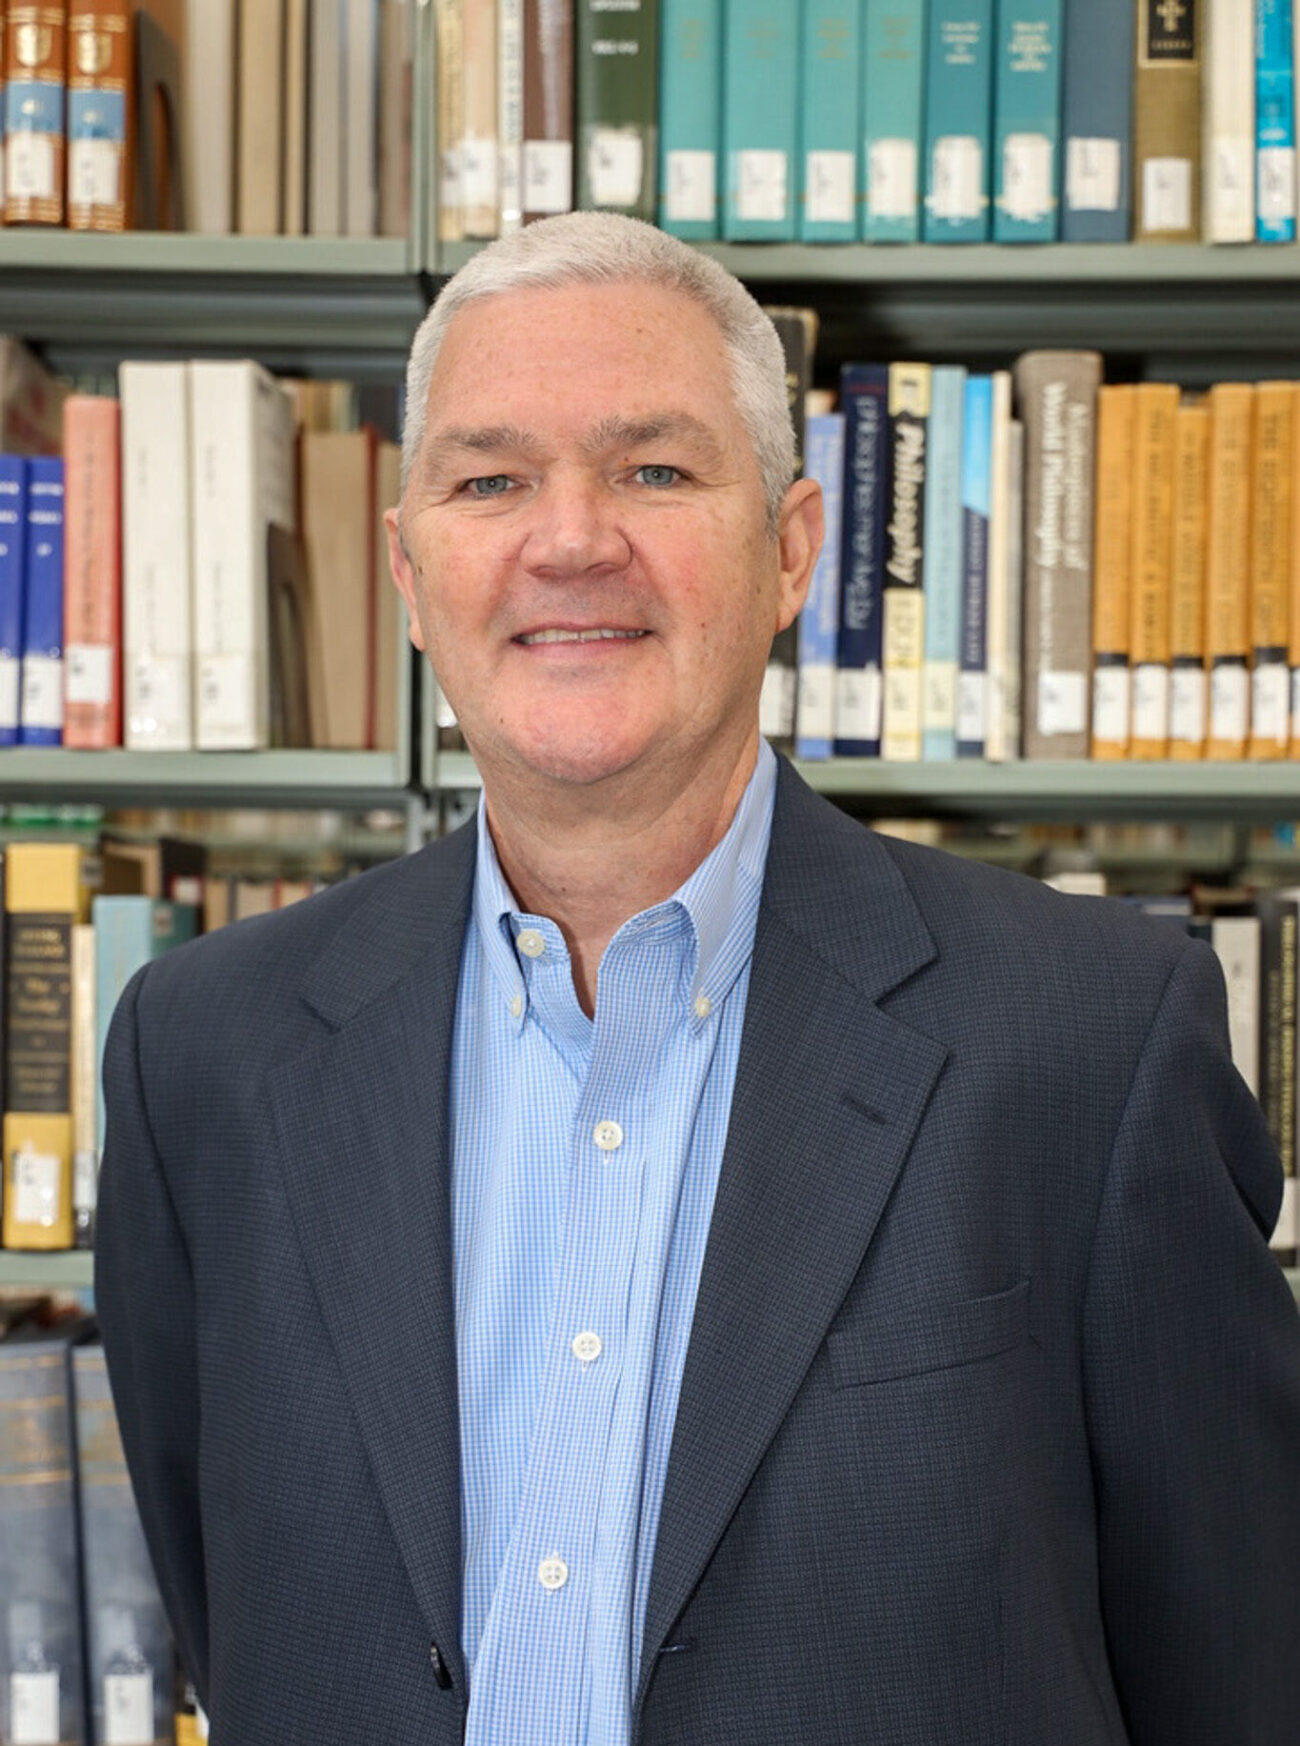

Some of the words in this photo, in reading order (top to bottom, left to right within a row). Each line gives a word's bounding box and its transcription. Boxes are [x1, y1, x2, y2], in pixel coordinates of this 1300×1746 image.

[1042, 382, 1068, 450] World
[887, 422, 925, 583] Philosophy
[1034, 452, 1065, 569] Philosophy
